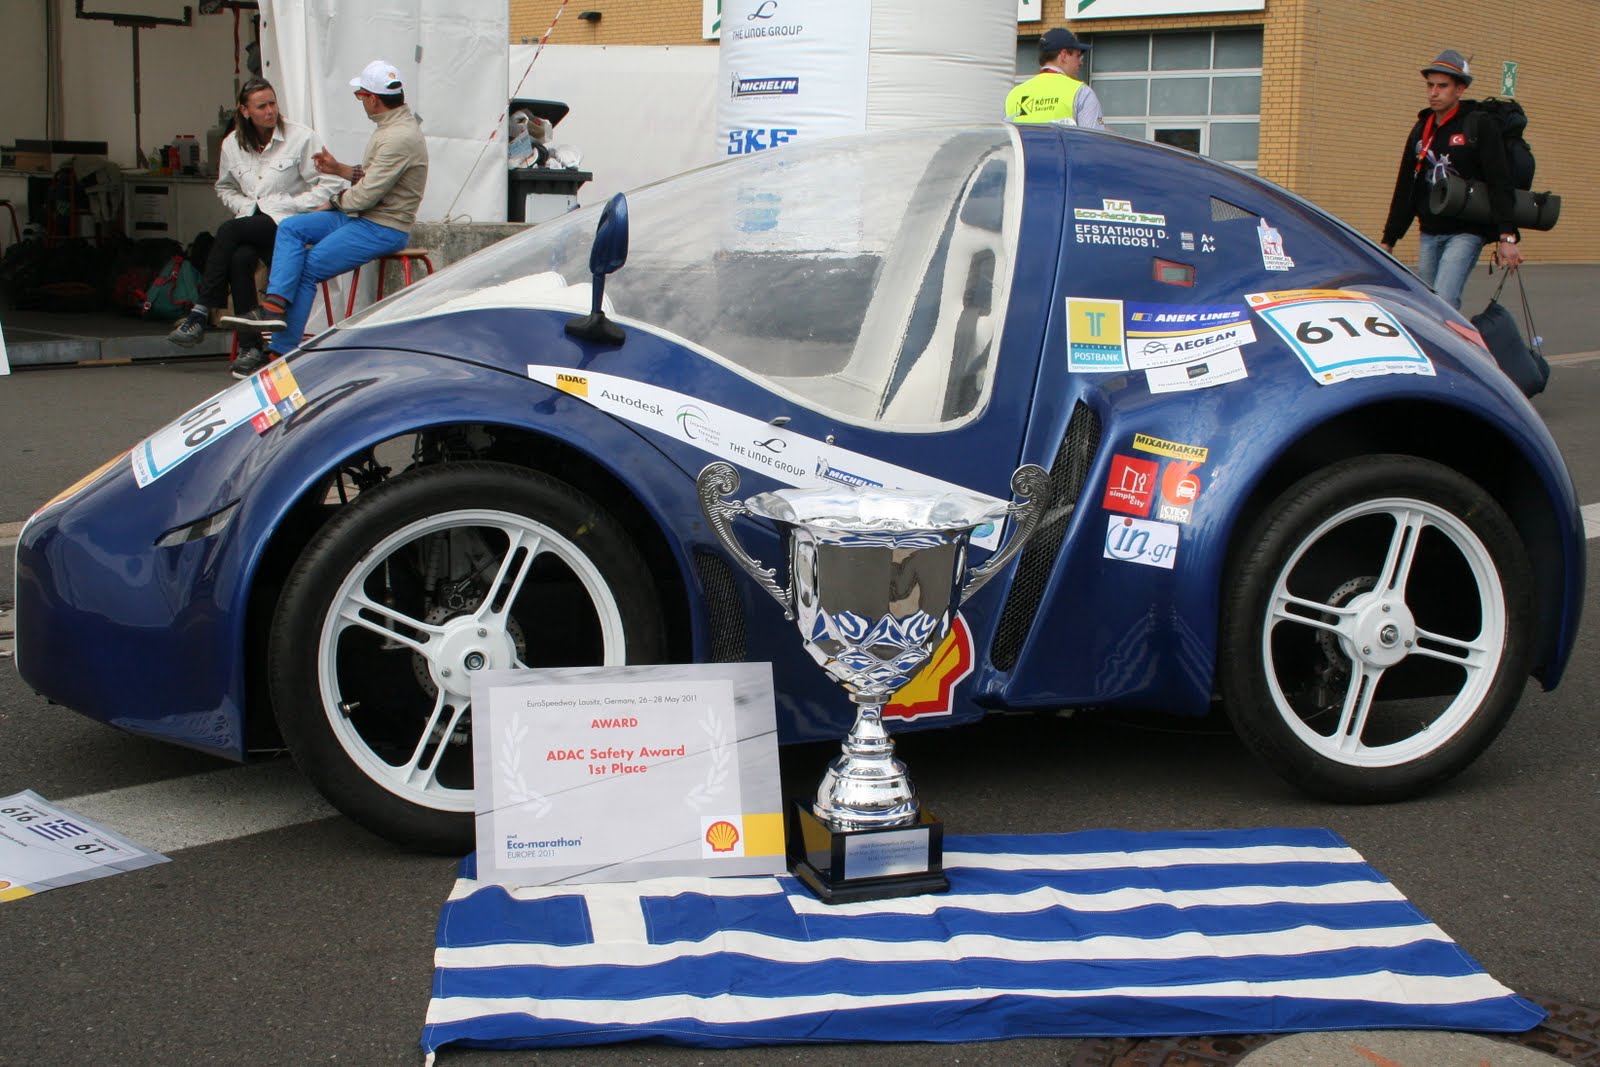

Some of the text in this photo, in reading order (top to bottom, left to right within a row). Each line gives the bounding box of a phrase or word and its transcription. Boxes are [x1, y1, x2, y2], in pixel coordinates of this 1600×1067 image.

[732, 25, 803, 40] THE LINDE GROUP
[740, 80, 797, 92] MICHELIN
[1035, 97, 1059, 106] KÖTTER
[1034, 104, 1055, 112] Security
[727, 129, 797, 155] SKF
[1105, 200, 1130, 212] TUC
[1075, 210, 1165, 224] Eco-Racing Team
[1075, 224, 1169, 239] EFSTATHIOU D.
[1076, 234, 1159, 248] STRATIGOS I.
[1200, 233, 1215, 243] A+
[1202, 243, 1216, 253] A+
[1155, 311, 1241, 323] ANEK LINES
[1296, 316, 1400, 344] 616
[1173, 330, 1237, 353] AEGEAN
[1074, 352, 1120, 362] POSTBANK
[557, 373, 587, 385] ADAC
[600, 389, 664, 417] Autodesk
[1136, 435, 1205, 457] ΜΙΧΑΗΛΑΚΗΣ
[729, 442, 806, 477] THE LINDE GROUP
[1109, 490, 1136, 500] simple
[1130, 497, 1144, 508] city
[1114, 517, 1177, 563] in.gr
[526, 699, 576, 709] EuroSpeedway
[578, 698, 601, 706] Lausitz,
[604, 697, 637, 706] Germany,
[664, 696, 680, 704] May
[591, 717, 638, 728] AWARD
[546, 745, 685, 761] ADAC Safety Award
[588, 763, 648, 775] 1st Place
[0, 807, 39, 822] 616
[74, 843, 106, 855] 61
[507, 836, 581, 850] Eco-marathon
[507, 849, 555, 859] EUROPE 2011
